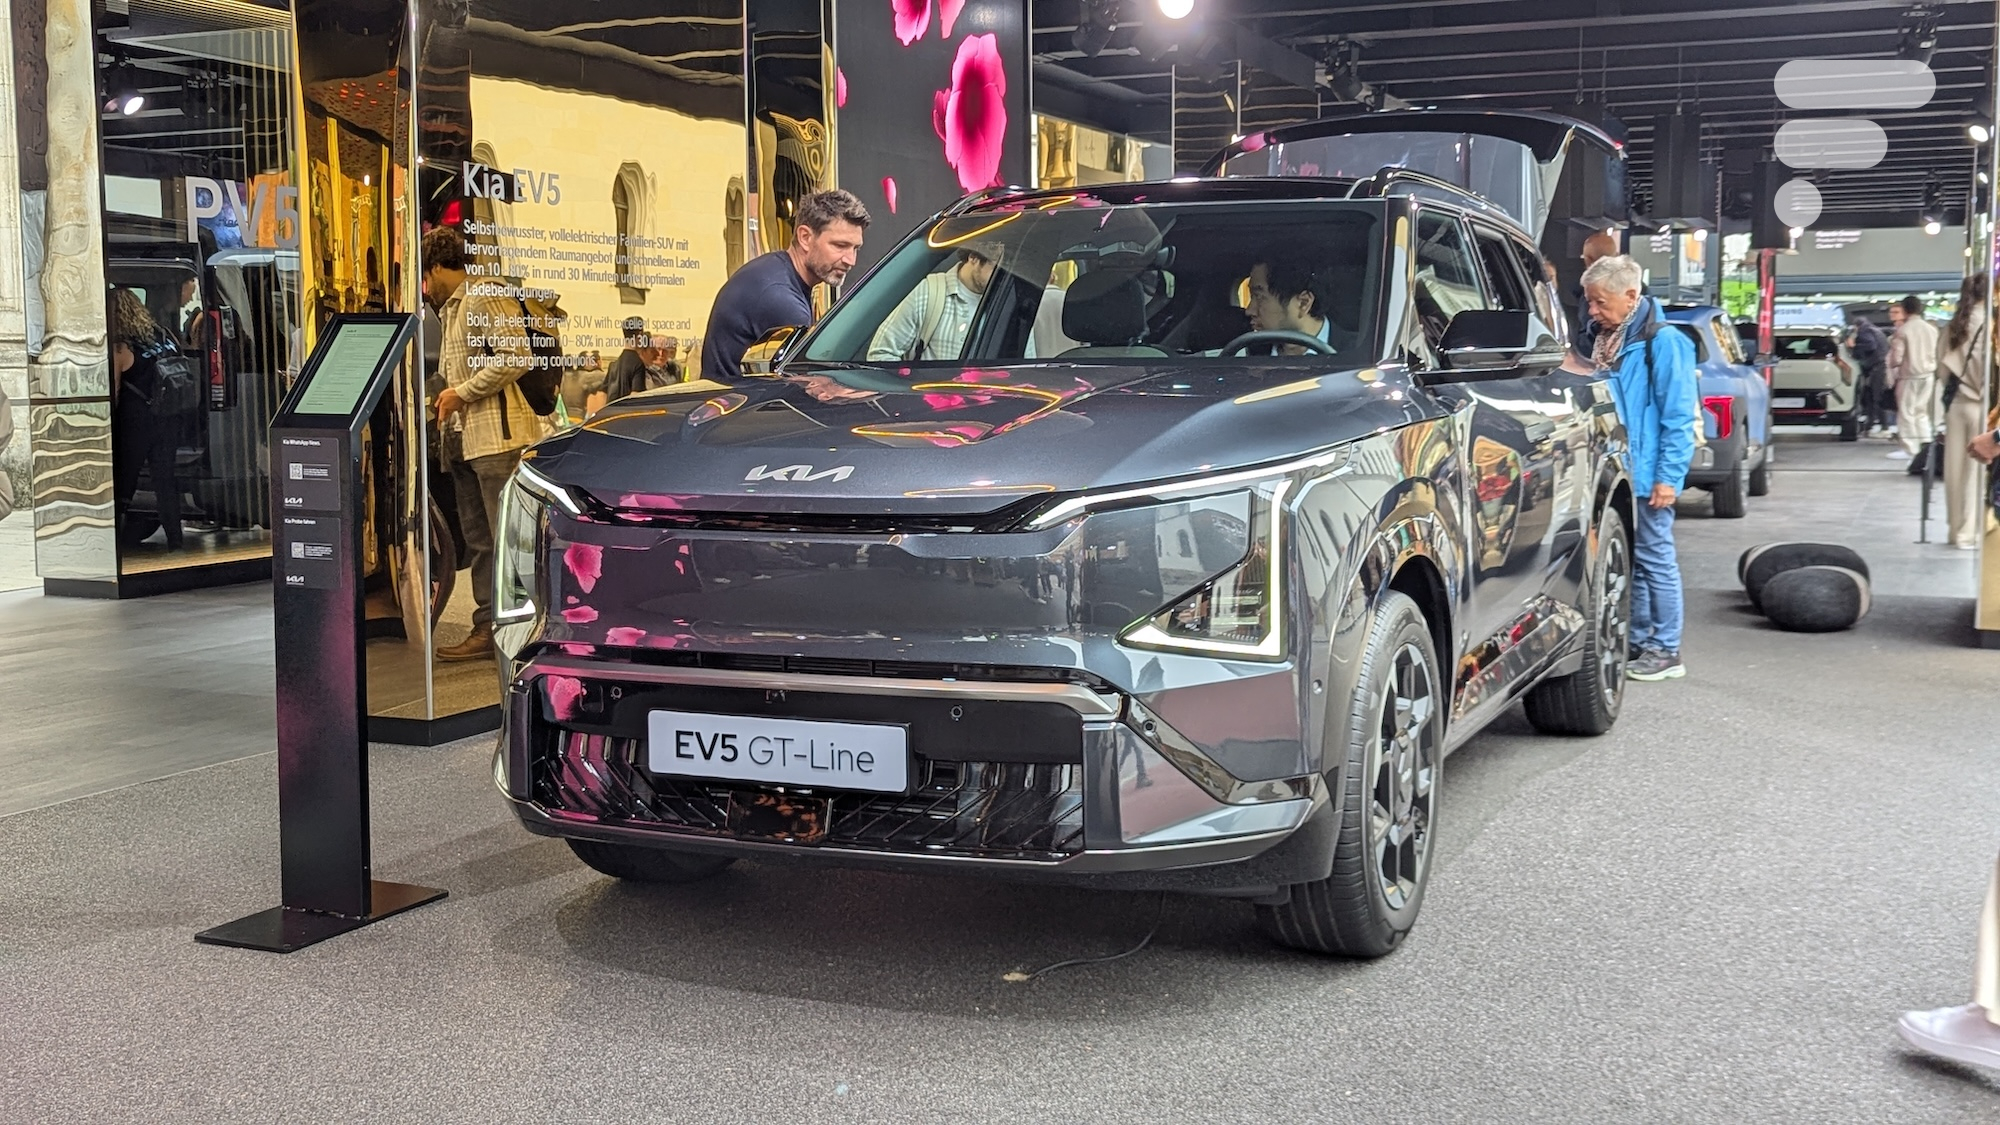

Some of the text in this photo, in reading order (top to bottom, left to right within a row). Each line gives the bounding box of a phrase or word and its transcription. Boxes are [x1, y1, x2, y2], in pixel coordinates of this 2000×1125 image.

[463, 161, 561, 206] Kia EV5
[184, 175, 299, 249] PV5
[463, 219, 689, 251] Selbstbewusster, vollelektrischer Familien-SUV mit
[464, 239, 700, 269] hervorragendem Raumangebot und schnellem Laden
[464, 263, 485, 276] von
[487, 262, 500, 276] 10
[532, 265, 541, 278] in
[543, 267, 566, 280] rund
[568, 267, 580, 281] 30
[582, 268, 619, 283] Minuten
[620, 272, 643, 284] unter
[645, 273, 685, 287] optimalen
[465, 281, 559, 300] Ladebedingungen.
[466, 312, 691, 332] Bold, all-electric family SUV with excellent space and
[466, 332, 486, 347] fast
[487, 333, 531, 351] charging
[532, 333, 555, 348] from
[595, 335, 604, 348] in
[605, 335, 635, 348] around
[637, 335, 649, 348] 30
[467, 353, 505, 370] optimal
[506, 353, 549, 371] charging
[744, 464, 855, 482] KIA
[675, 730, 875, 773] EV5 GT-Line
